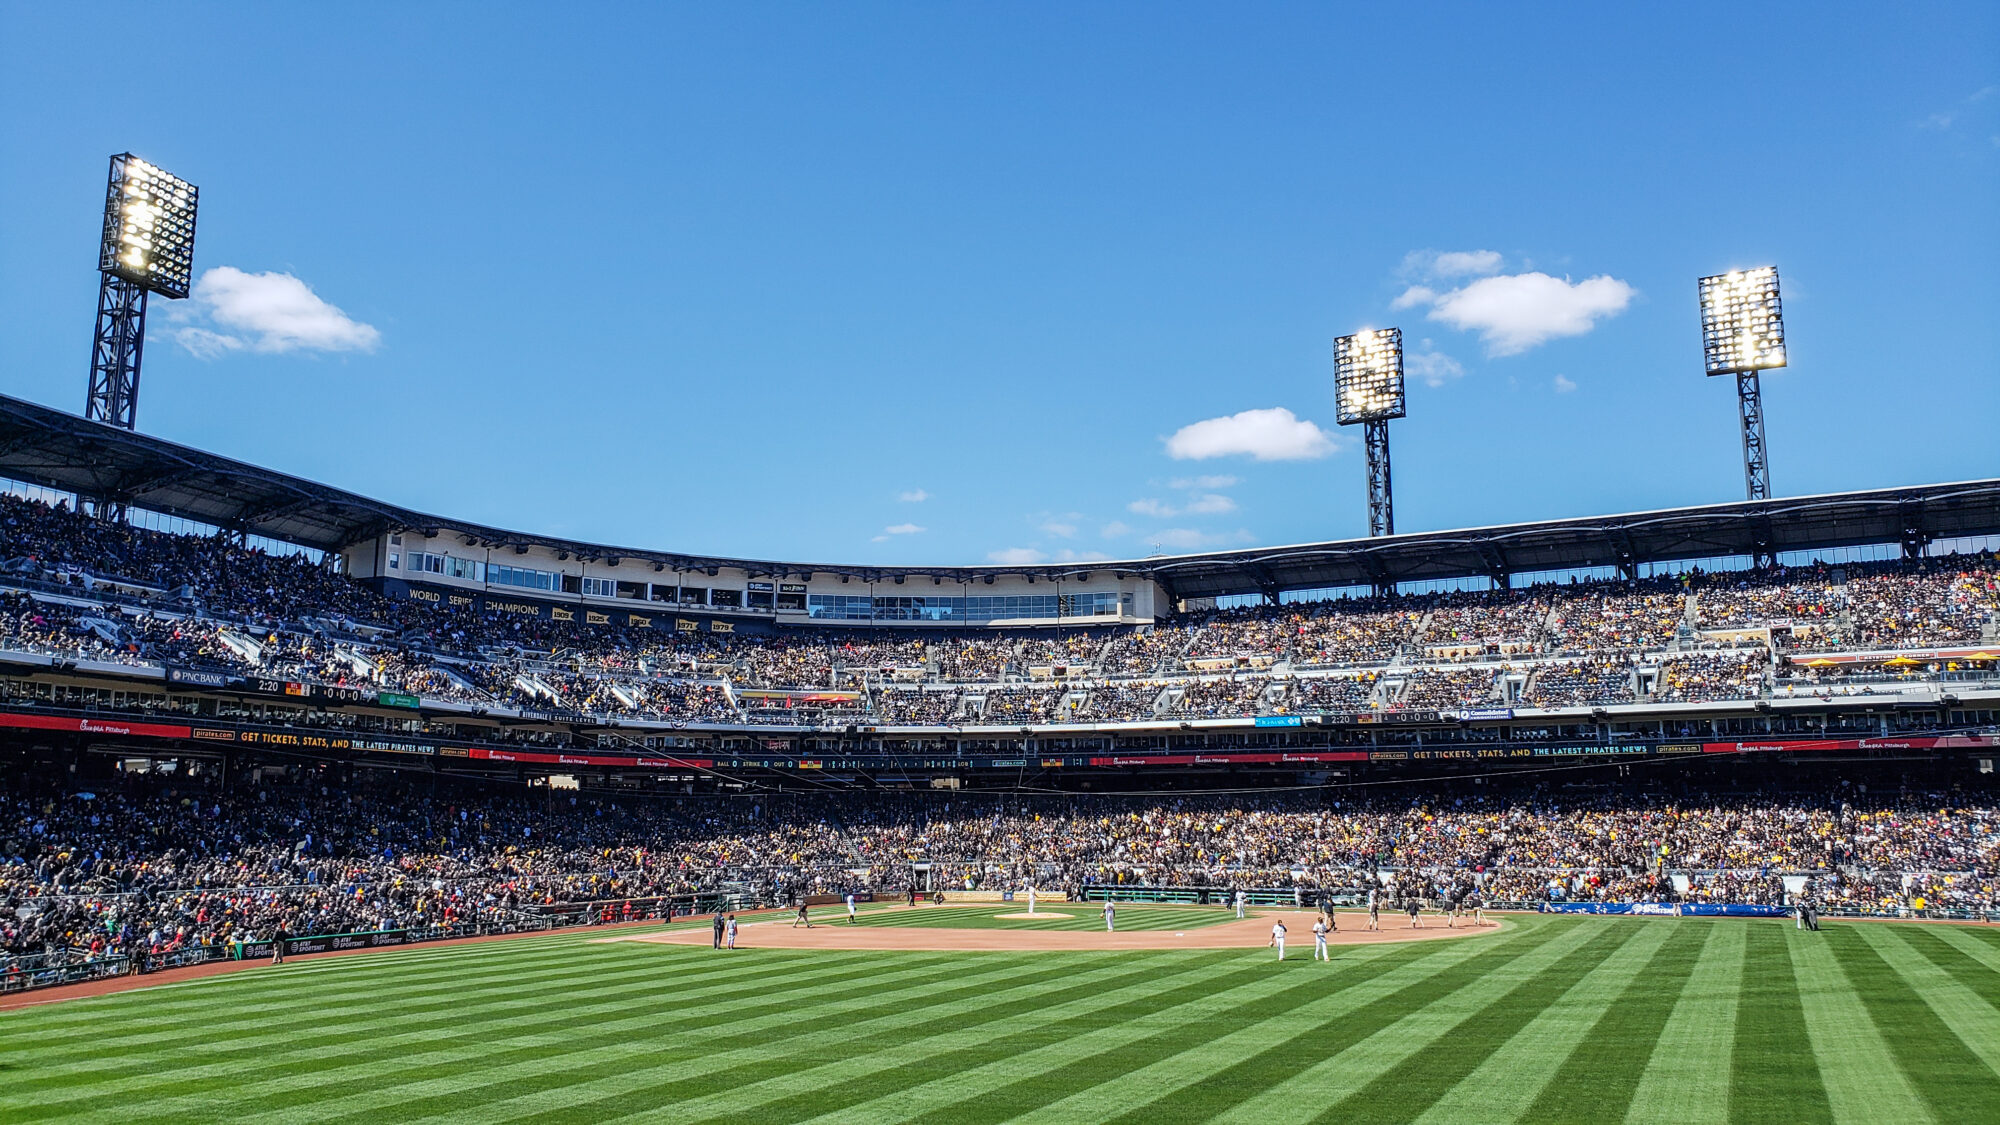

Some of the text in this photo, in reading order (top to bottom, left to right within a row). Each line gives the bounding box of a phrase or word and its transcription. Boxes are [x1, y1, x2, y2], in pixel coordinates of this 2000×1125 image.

[409, 589, 440, 602] WORLD
[485, 601, 540, 615] CHAMPIONS
[553, 611, 569, 619] 1909
[588, 614, 605, 623] 1925
[712, 623, 729, 632] 1979
[182, 671, 222, 684] PNC BANK
[258, 680, 279, 692] 2:20
[1331, 716, 1350, 724] 2:20
[105, 726, 130, 734] Pittsburgh
[196, 730, 233, 739] pirates.com
[241, 732, 435, 753] GET TICKETS, STATS, AND THE LATEST PIRATES NEWS
[1413, 745, 1647, 759] GET TICKETS, STATS, AND THE LATEST PIRATES NEWS
[1658, 745, 1698, 753] pirates.com
[299, 944, 326, 952] SPORTSNET
